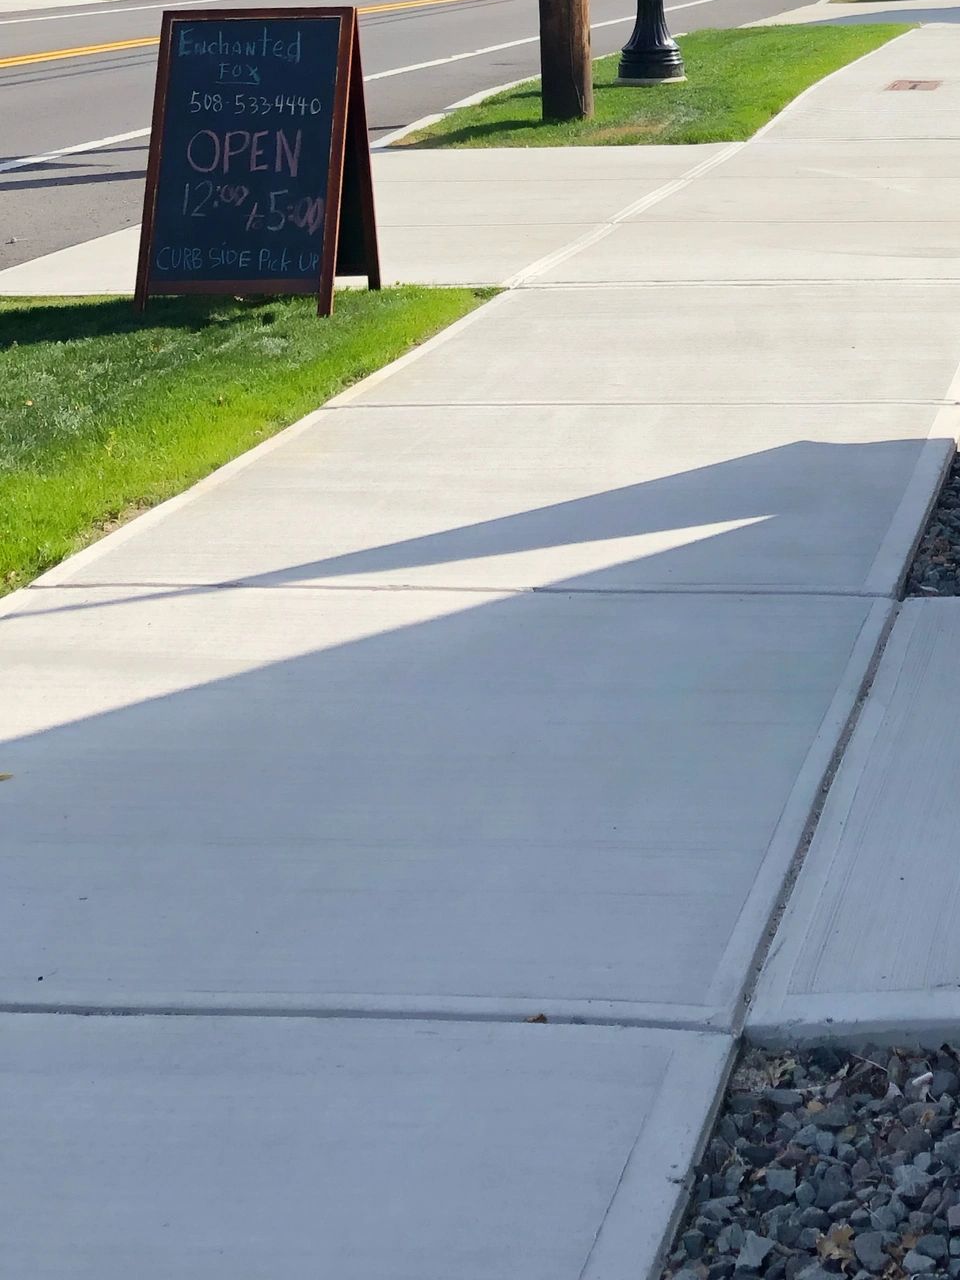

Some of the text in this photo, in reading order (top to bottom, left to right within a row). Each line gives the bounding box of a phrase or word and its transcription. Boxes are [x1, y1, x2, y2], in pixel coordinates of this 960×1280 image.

[219, 63, 261, 82] FOX
[187, 128, 302, 177] OPEN
[156, 246, 203, 271] CURB
